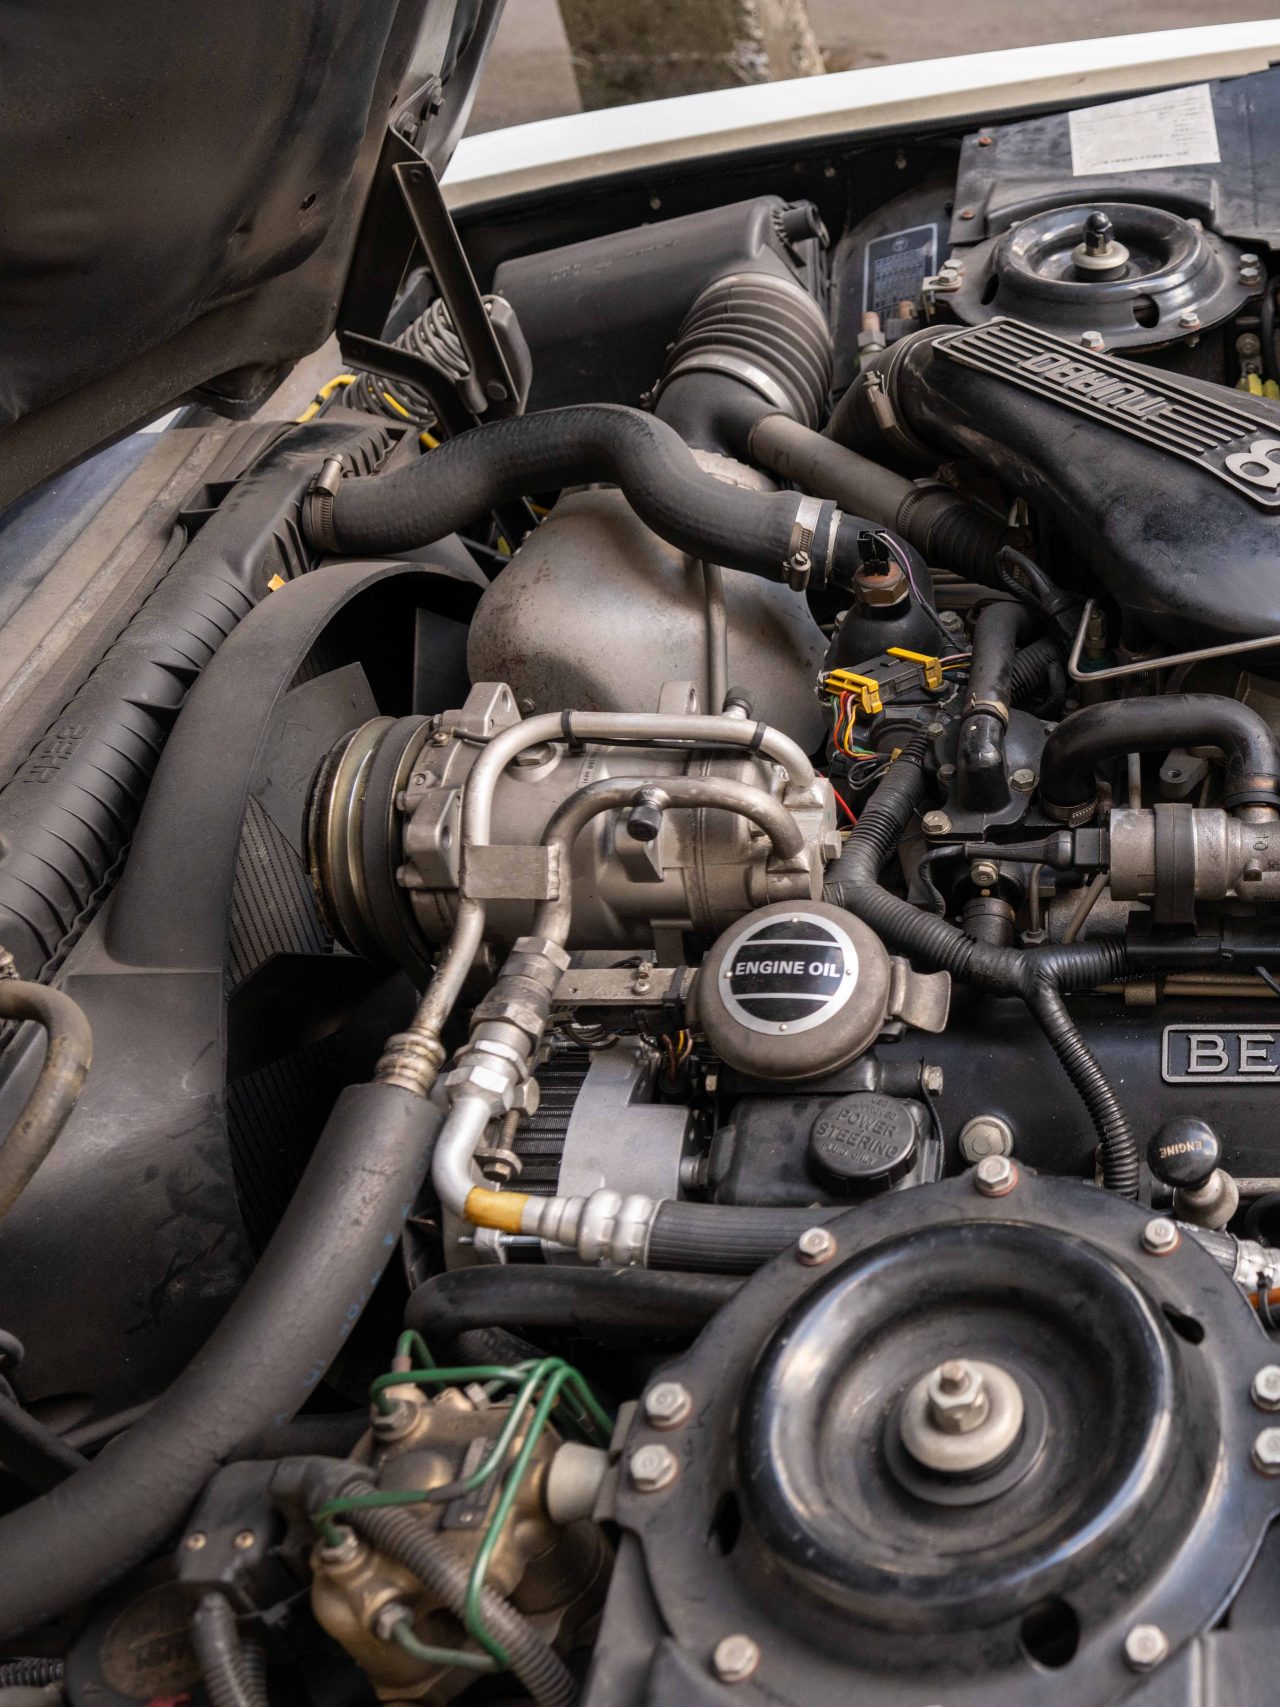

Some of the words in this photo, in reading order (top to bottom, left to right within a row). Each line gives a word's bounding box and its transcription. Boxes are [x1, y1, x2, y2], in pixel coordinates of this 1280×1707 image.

[1020, 352, 1166, 418] TURBO
[23, 723, 94, 783] BEHR
[735, 961, 806, 975] ENGINE
[808, 962, 841, 978] OIL
[836, 1108, 897, 1139] POWER
[816, 1121, 898, 1159] STEERING
[1159, 1141, 1204, 1158] ENGINE
[851, 1153, 876, 1165] ONLY
